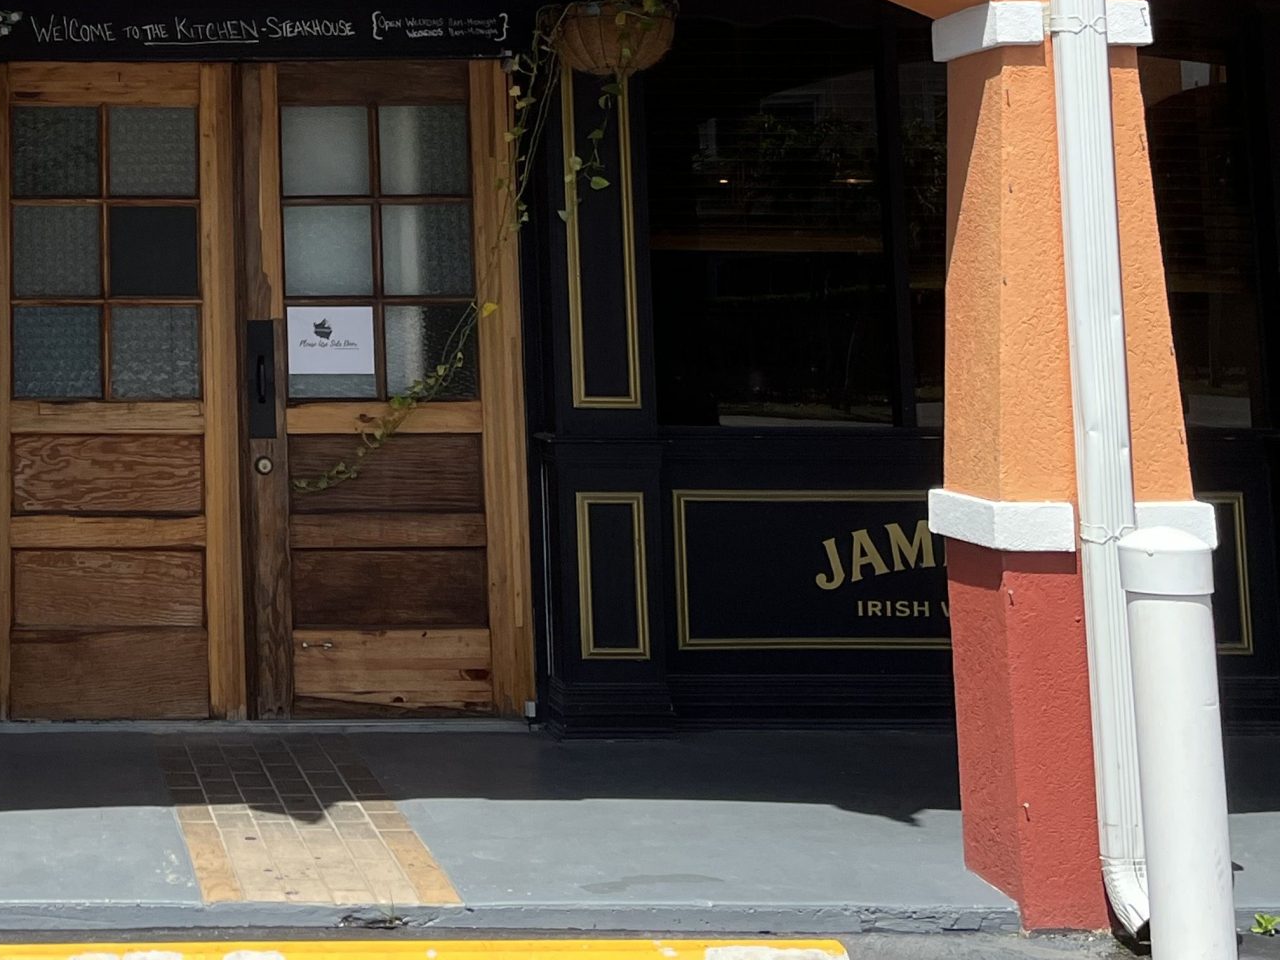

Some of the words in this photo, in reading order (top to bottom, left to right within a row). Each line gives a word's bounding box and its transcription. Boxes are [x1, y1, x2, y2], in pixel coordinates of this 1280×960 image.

[123, 26, 139, 40] TO
[143, 24, 168, 38] THE
[815, 520, 947, 590] JAM
[857, 600, 930, 617] IRISH
